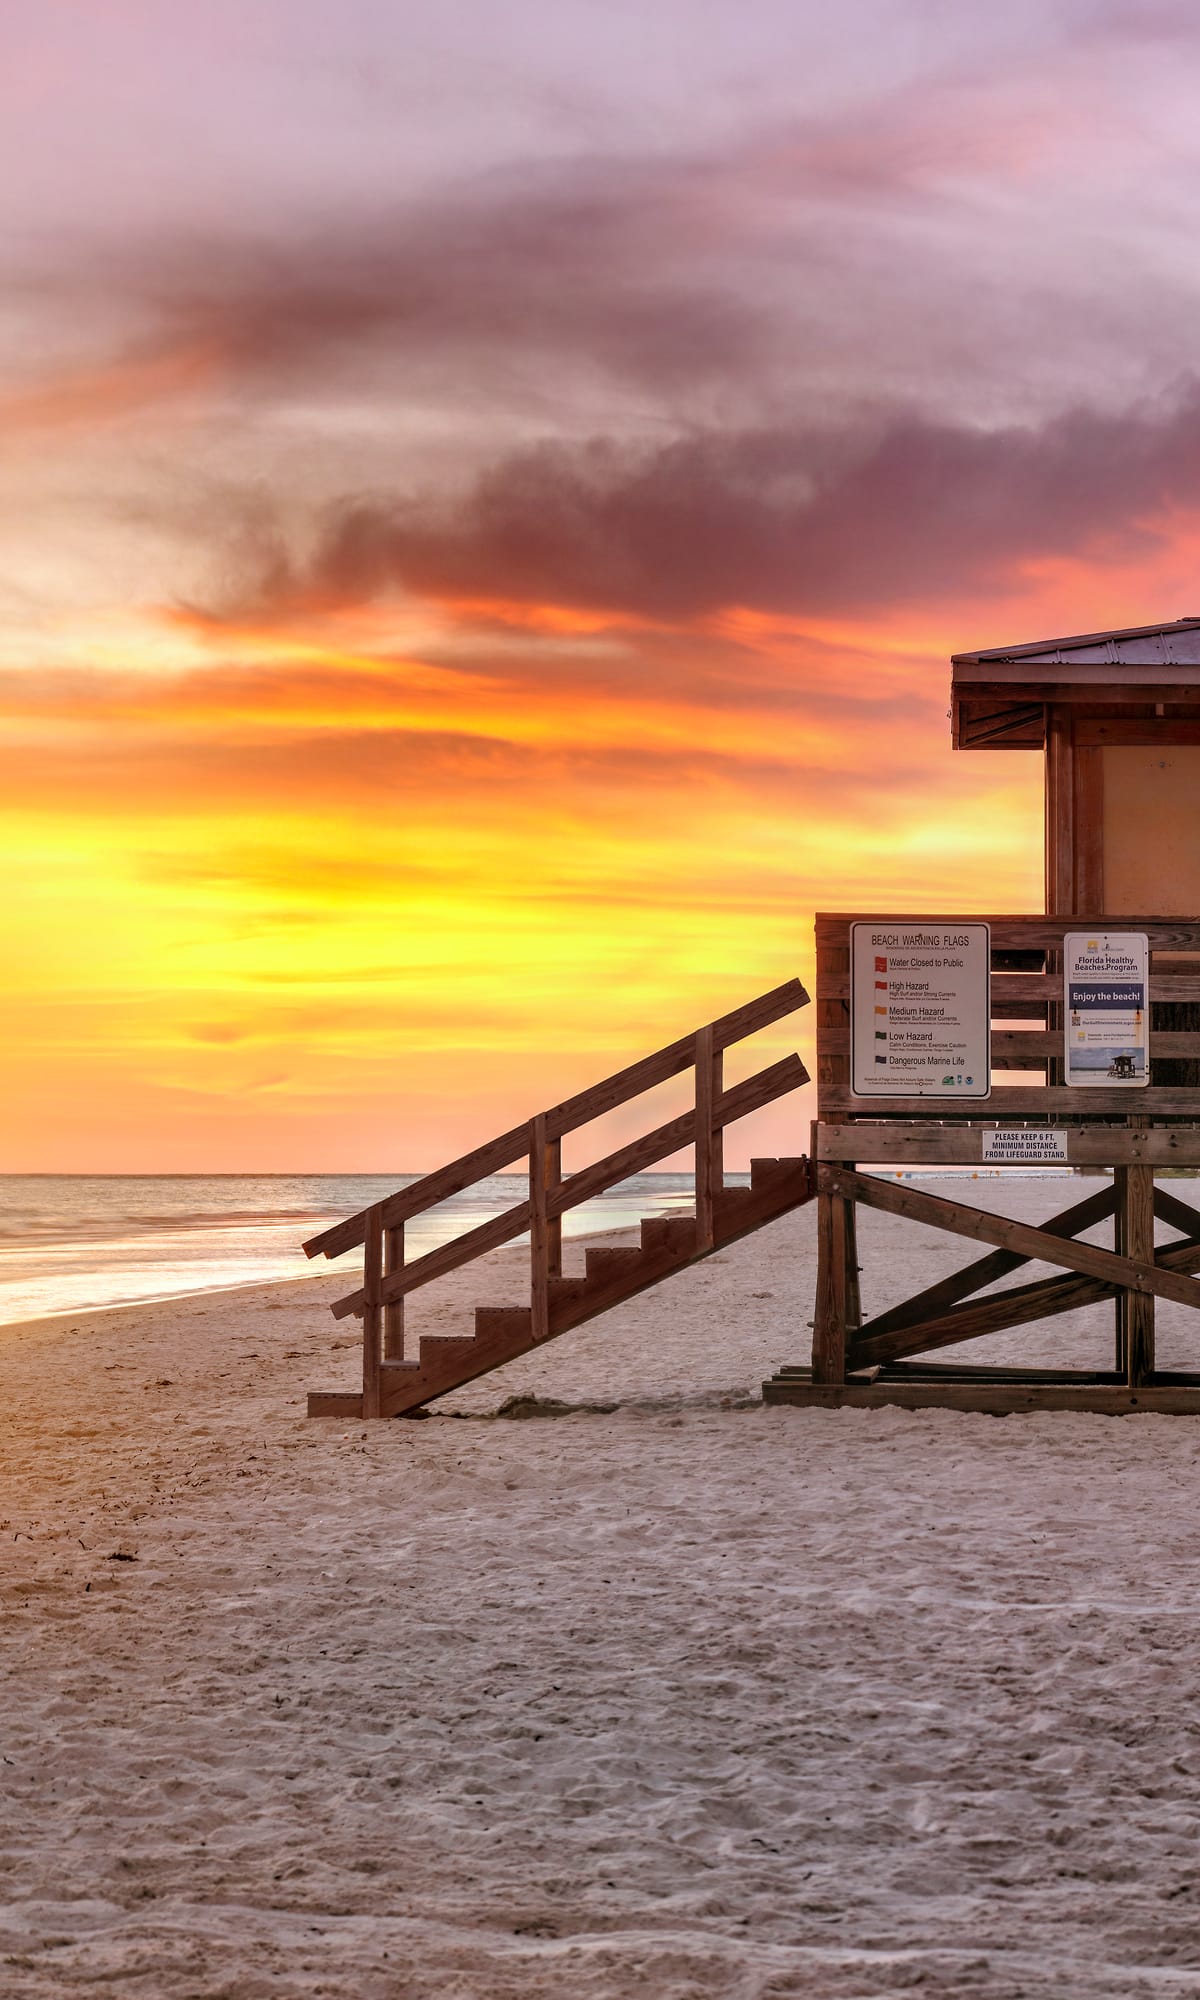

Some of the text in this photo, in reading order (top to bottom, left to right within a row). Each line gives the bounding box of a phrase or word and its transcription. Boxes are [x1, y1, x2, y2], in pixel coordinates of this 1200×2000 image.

[872, 935, 969, 946] BEACH WARNING FLAGS
[910, 958, 933, 967] Closed
[943, 959, 963, 967] Public
[889, 982, 929, 992] High Hazard
[1073, 992, 1096, 1002] Enjoy
[1113, 992, 1140, 1000] beach!
[889, 1007, 944, 1015] Medium Hazard
[889, 1032, 932, 1040] Low Hazard
[889, 1056, 965, 1066] Dangerous Marine Life
